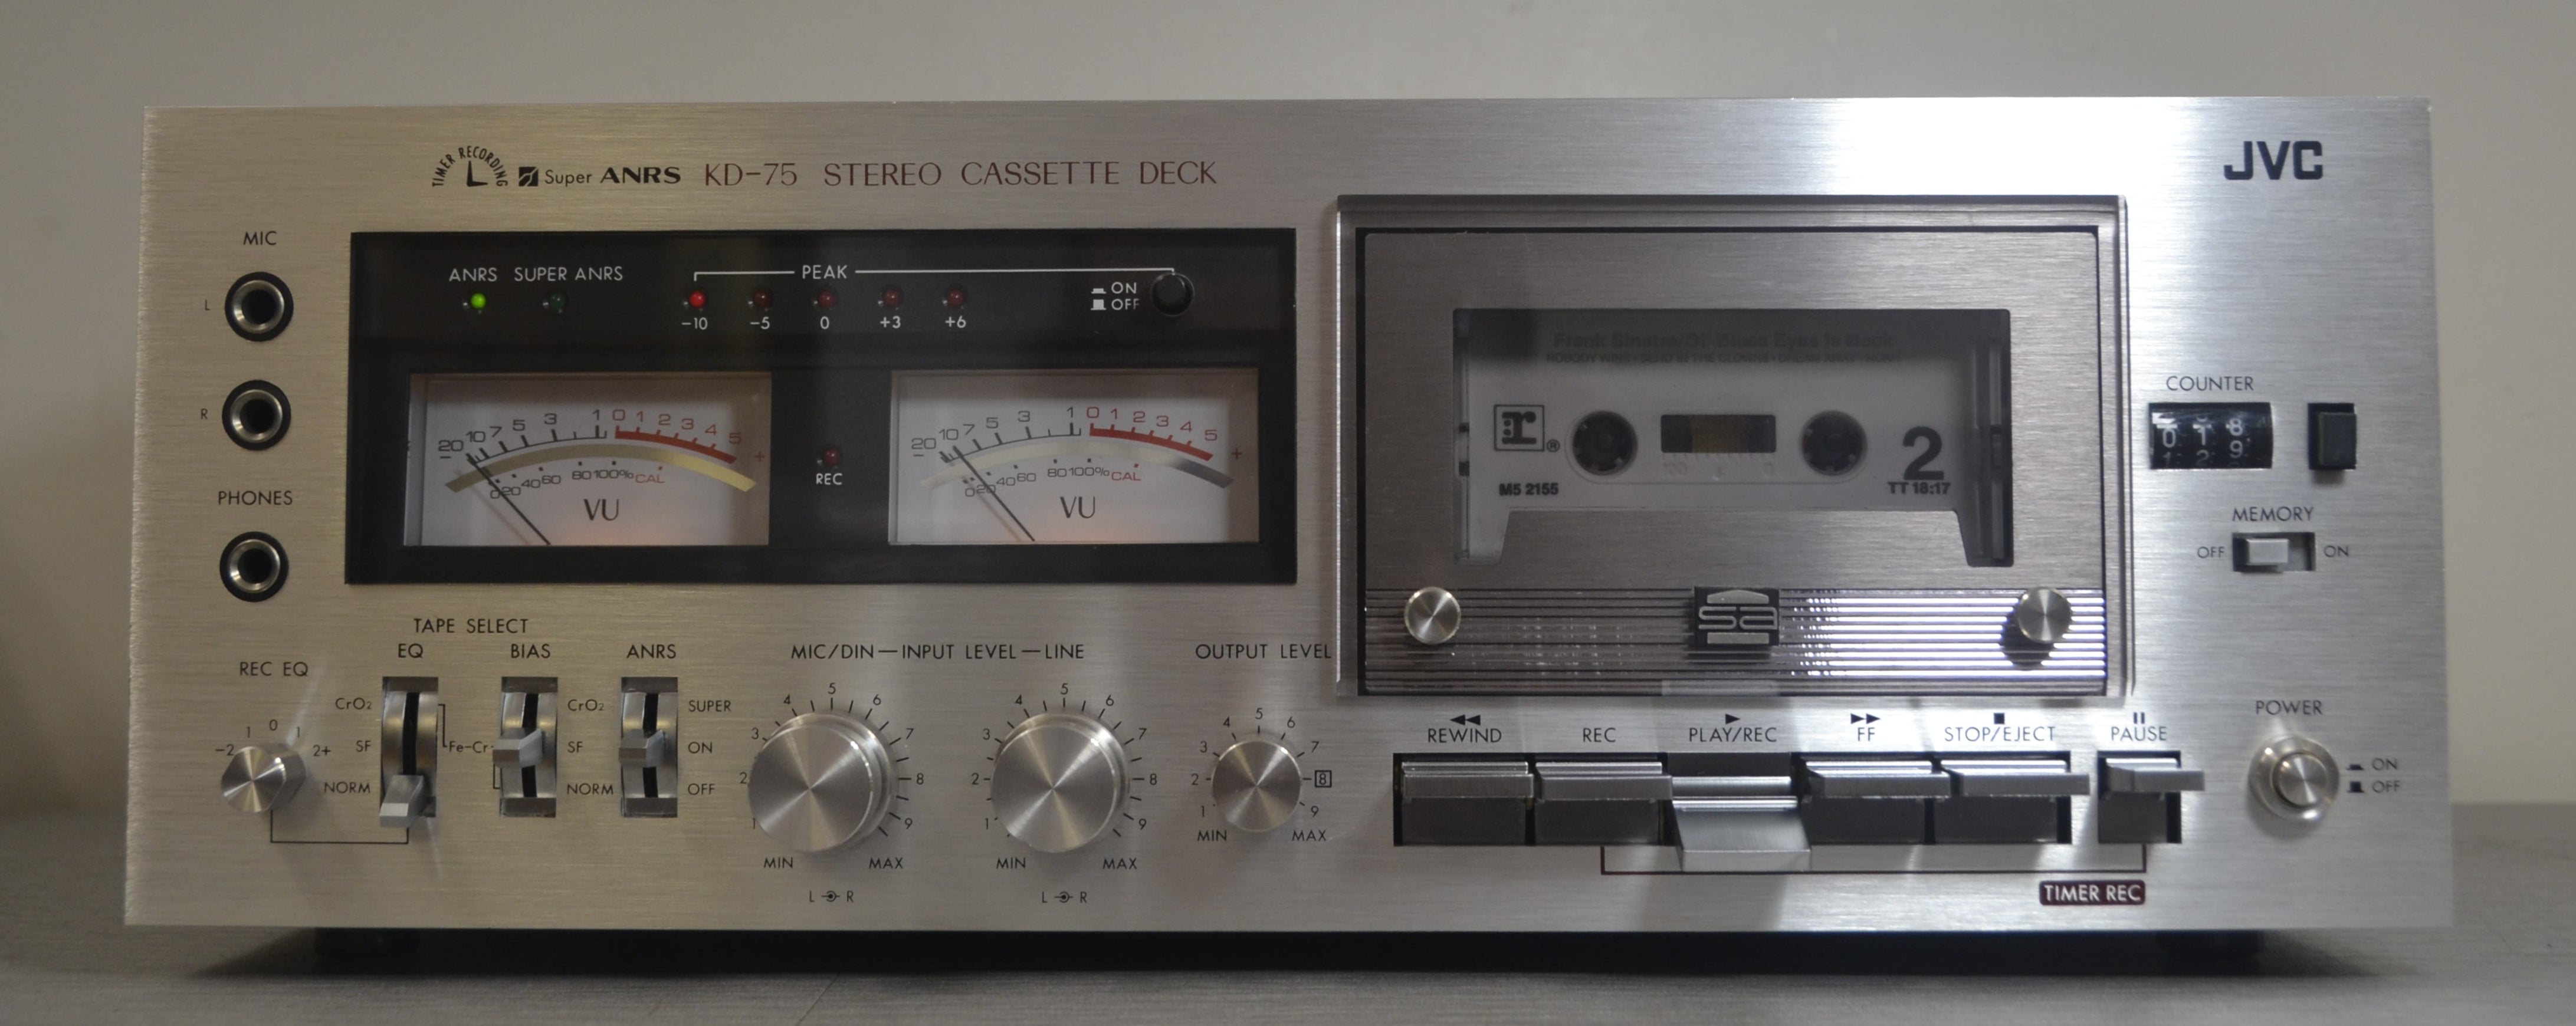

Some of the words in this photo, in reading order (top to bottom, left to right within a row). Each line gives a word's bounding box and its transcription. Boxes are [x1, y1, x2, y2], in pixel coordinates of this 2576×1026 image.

[432, 154, 455, 187] TIMER
[458, 146, 508, 186] RECORDING
[2224, 141, 2323, 180] JVC
[545, 169, 592, 187] Super
[600, 167, 681, 183] ANRS
[705, 163, 798, 186] KD-75
[824, 163, 941, 186] STEREO
[961, 161, 1120, 185] CASSETTE
[1140, 161, 1217, 185] DECK
[243, 232, 277, 245] MIC
[449, 268, 497, 282] ANRS
[514, 267, 567, 282] SUPER
[575, 266, 623, 281] ANRS
[802, 265, 848, 279] PEAK
[1111, 282, 1137, 294] ON
[205, 300, 210, 311] L
[1111, 298, 1140, 311] OFF
[682, 317, 707, 330] -10
[750, 317, 770, 329] -5
[821, 317, 829, 329] 0
[880, 315, 901, 329] +3
[945, 315, 966, 328] +6
[2166, 376, 2253, 391] COUNTER
[201, 409, 208, 420] R
[438, 440, 464, 452] 20
[466, 431, 485, 442] 10
[490, 426, 502, 438] 7
[513, 419, 525, 431] 5
[544, 413, 557, 425] 3
[592, 409, 600, 420] 1
[612, 409, 625, 421] 0
[637, 411, 644, 422] 1
[658, 414, 671, 425] 2
[681, 419, 694, 430] 3
[705, 425, 717, 435] 4
[729, 432, 741, 444] 5
[911, 438, 936, 449] 20
[939, 429, 959, 440] 10
[963, 424, 974, 435] 7
[986, 417, 999, 429] 5
[1018, 410, 1030, 422] 3
[1067, 407, 1074, 417] 1
[1087, 407, 1100, 418] 0
[1111, 409, 1117, 419] 1
[1133, 412, 1146, 422] 2
[1156, 416, 1169, 427] 3
[1180, 421, 1192, 432] 4
[1205, 430, 1218, 440] 5
[1903, 426, 1944, 480] 2
[501, 486, 521, 496] 20
[521, 479, 540, 488] 40
[542, 475, 561, 484] 60
[572, 471, 592, 480] 80
[594, 470, 634, 479] 100%
[635, 475, 665, 484] CAL
[816, 473, 842, 485] REC
[965, 488, 974, 497] 0
[996, 477, 1015, 486] 40
[1017, 473, 1036, 482] 60
[1048, 468, 1067, 478] 80
[1069, 467, 1109, 476] 100%
[1111, 472, 1141, 481] CAL
[1525, 483, 1558, 495] 2155
[1888, 482, 1909, 494] TT
[1912, 482, 1951, 494] 18:17
[218, 491, 293, 505] PHONES
[583, 499, 619, 521] VU
[1060, 496, 1095, 518] VU
[2233, 507, 2314, 521] MEMORY
[2197, 547, 2224, 558] OFF
[2324, 545, 2348, 557] ON
[414, 619, 455, 633] TAPE
[467, 619, 529, 633] SELECT
[398, 643, 424, 659] EQ
[511, 643, 550, 659] BIAS
[626, 644, 676, 659] ANRS
[966, 644, 1016, 659] LEVEL
[1196, 644, 1268, 659] OUTPUT
[1281, 644, 1331, 659] LEVEL
[240, 662, 272, 676] REC
[283, 662, 309, 677] EQ
[828, 683, 836, 695] 5
[1061, 683, 1069, 695] 5
[688, 700, 731, 712] SUPER
[783, 695, 791, 705] 4
[873, 694, 881, 706] 6
[1015, 695, 1023, 705] 4
[1105, 695, 1114, 706] 6
[1255, 708, 1263, 719] 5
[2256, 700, 2322, 715] POWER
[1223, 716, 1230, 727] 4
[1287, 716, 1295, 728] 6
[246, 727, 251, 737] 1
[269, 719, 278, 731] 0
[296, 727, 300, 738] 1
[752, 728, 759, 739] 3
[906, 728, 914, 739] 7
[1139, 729, 1147, 739] 7
[1689, 727, 1777, 742] PLAY/REC
[1858, 727, 1876, 741] FF
[1945, 726, 2055, 742] STOP/EJECT
[2111, 726, 2167, 741] PAUSE
[983, 729, 990, 741] 3
[1428, 728, 1502, 743] REWIND
[1583, 728, 1616, 742] REC
[356, 741, 371, 752] SF
[449, 741, 490, 753] Fe-Cr
[568, 741, 583, 753] SF
[688, 742, 713, 754] ON
[1200, 741, 1207, 752] 3
[1311, 741, 1320, 752] 7
[2372, 758, 2397, 771] ON
[740, 772, 747, 784] 2
[917, 773, 924, 785] 8
[972, 773, 979, 785] 2
[1150, 774, 1157, 785] 8
[1192, 774, 1199, 785] 2
[1319, 773, 1326, 785] 8
[324, 781, 370, 794] NORM
[567, 783, 613, 795] NORM
[688, 783, 715, 795] OFF
[2372, 781, 2400, 793] OFF
[1201, 805, 1205, 817] 1
[1311, 805, 1318, 817] 9
[905, 818, 913, 830] 9
[985, 818, 989, 830] 1
[1138, 818, 1147, 830] 9
[1197, 830, 1227, 841] MIN
[1292, 830, 1326, 841] MAX
[764, 857, 793, 869] MIN
[869, 857, 903, 869] MAX
[996, 857, 1026, 869] MIN
[1102, 858, 1137, 869] MAX
[809, 891, 814, 902] L
[847, 891, 854, 902] R
[1042, 892, 1047, 903] L
[1080, 892, 1087, 903] R
[2045, 885, 2099, 902] TIMER
[2107, 884, 2141, 901] REC
